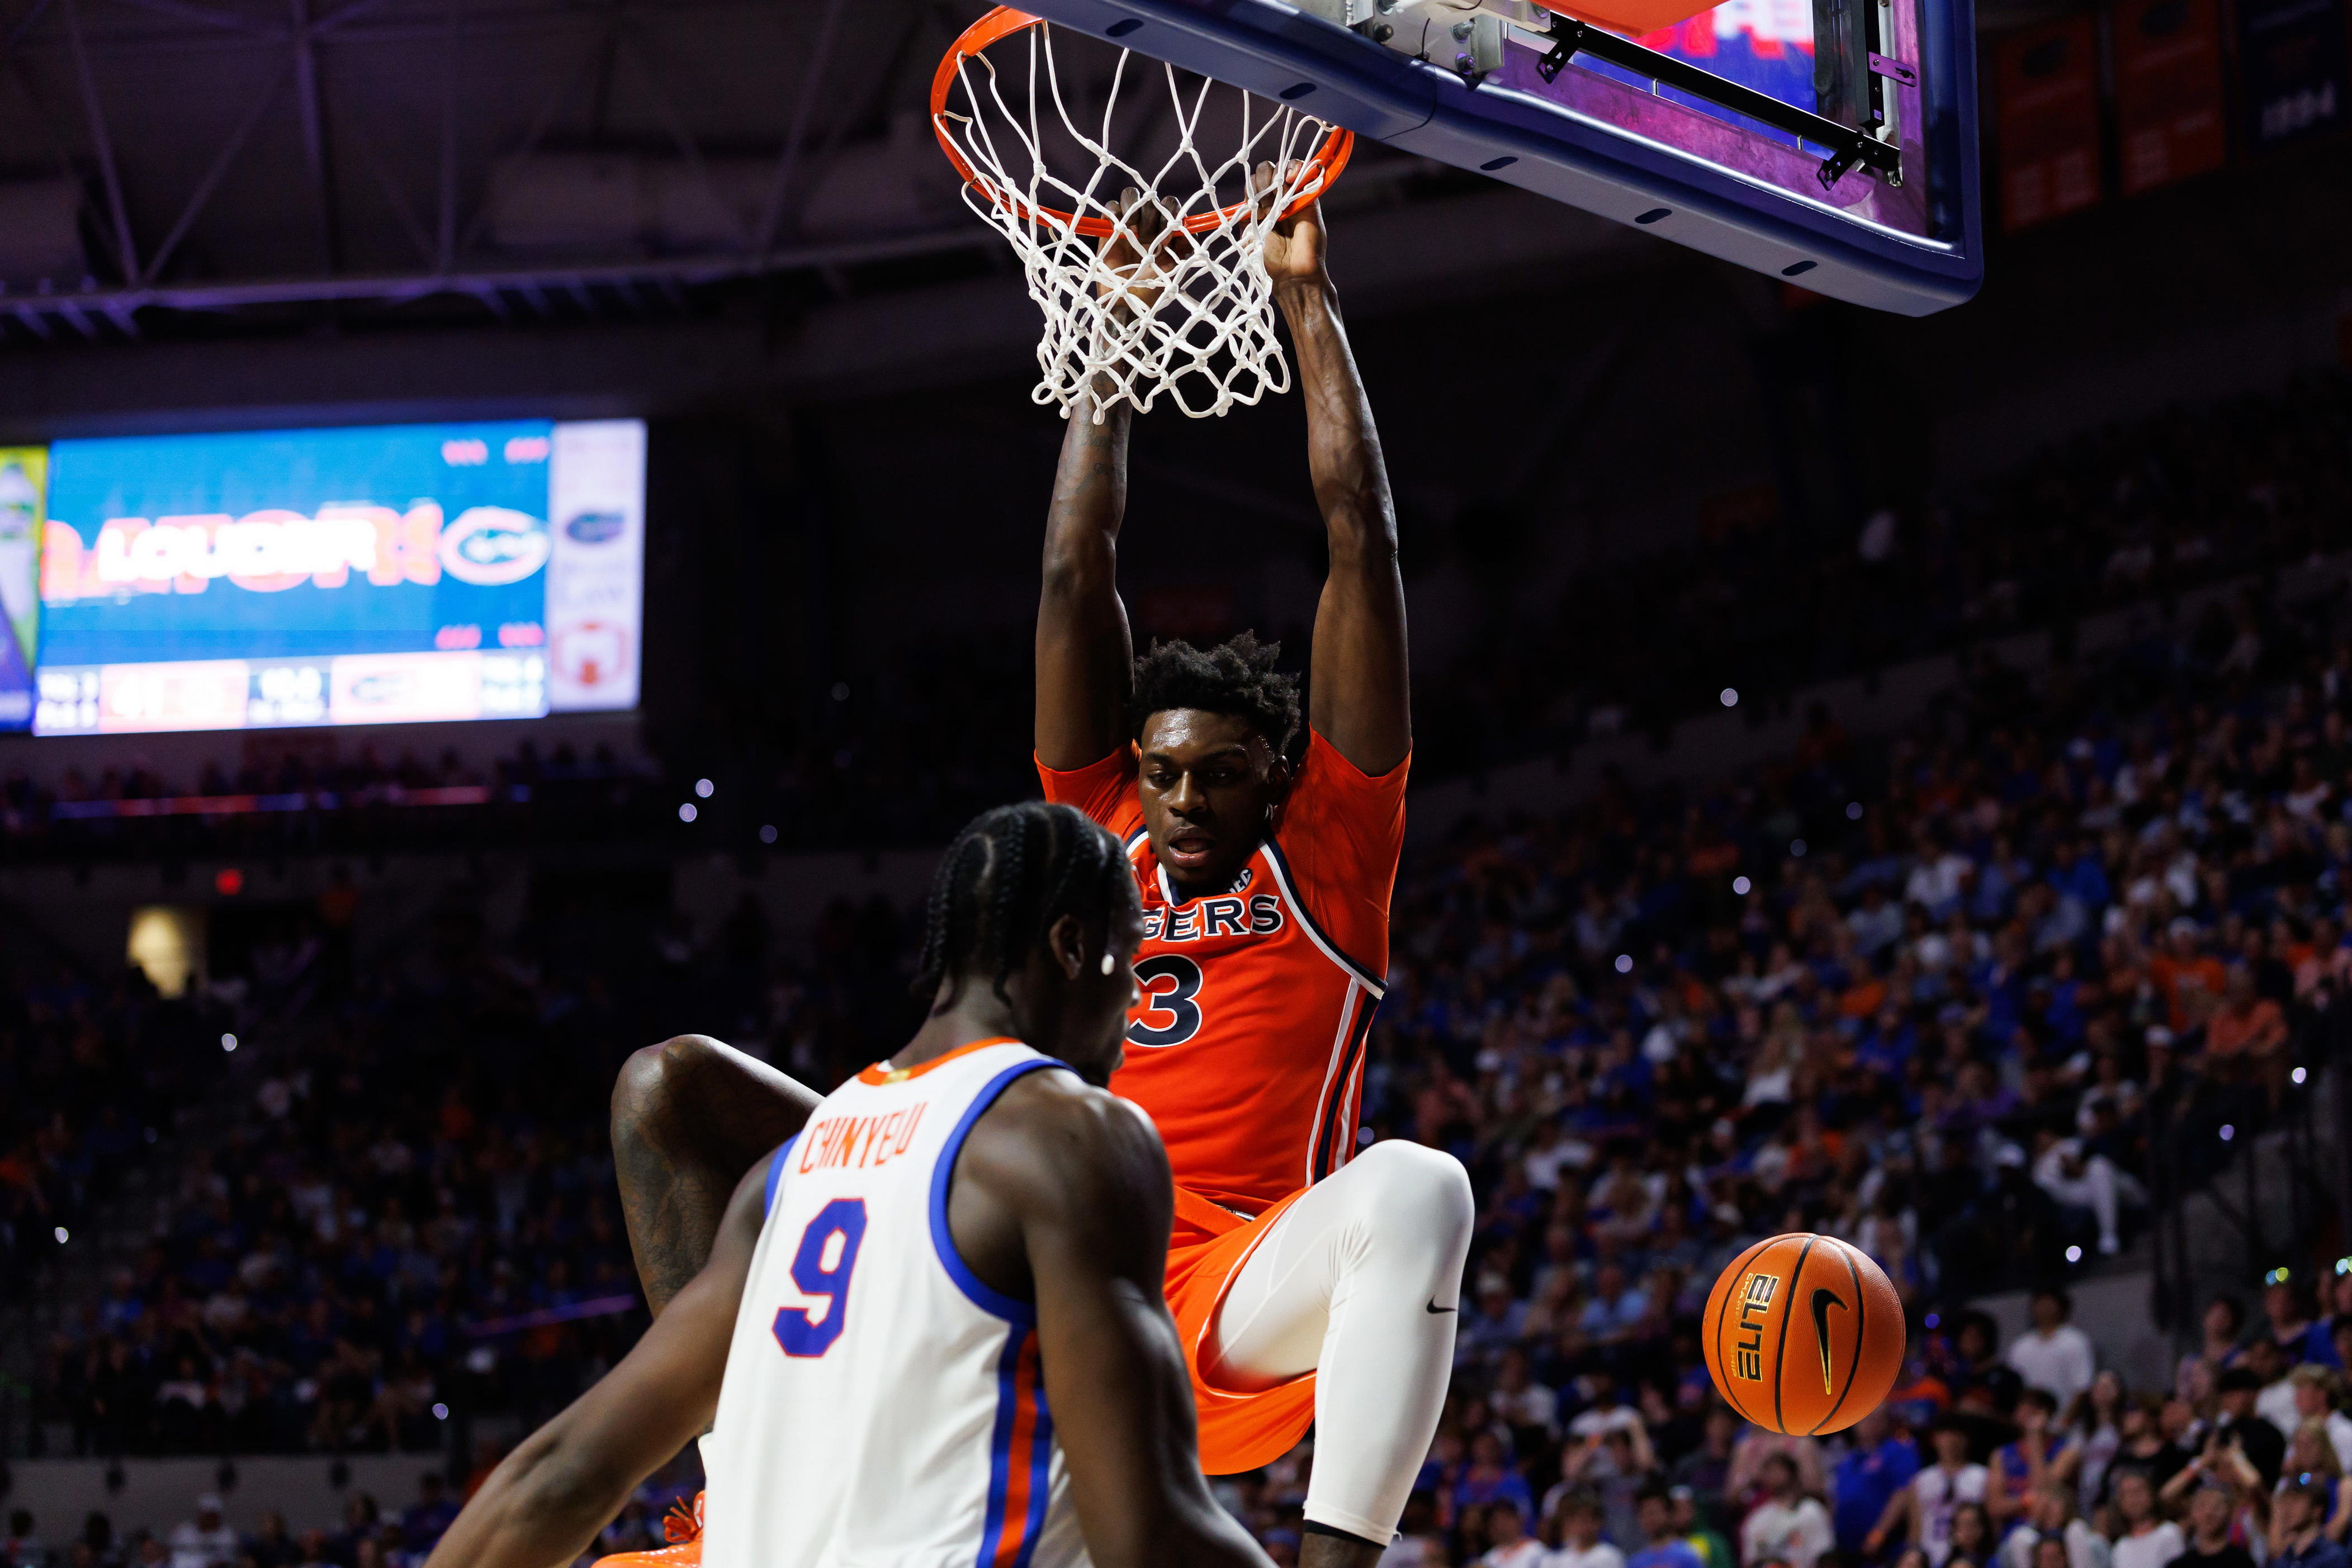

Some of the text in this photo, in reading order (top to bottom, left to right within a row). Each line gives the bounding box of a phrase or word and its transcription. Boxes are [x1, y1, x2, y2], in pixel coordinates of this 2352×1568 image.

[1125, 954, 1203, 1047] 3
[772, 1197, 868, 1357] 9
[1737, 1273, 1780, 1382] ELITE
